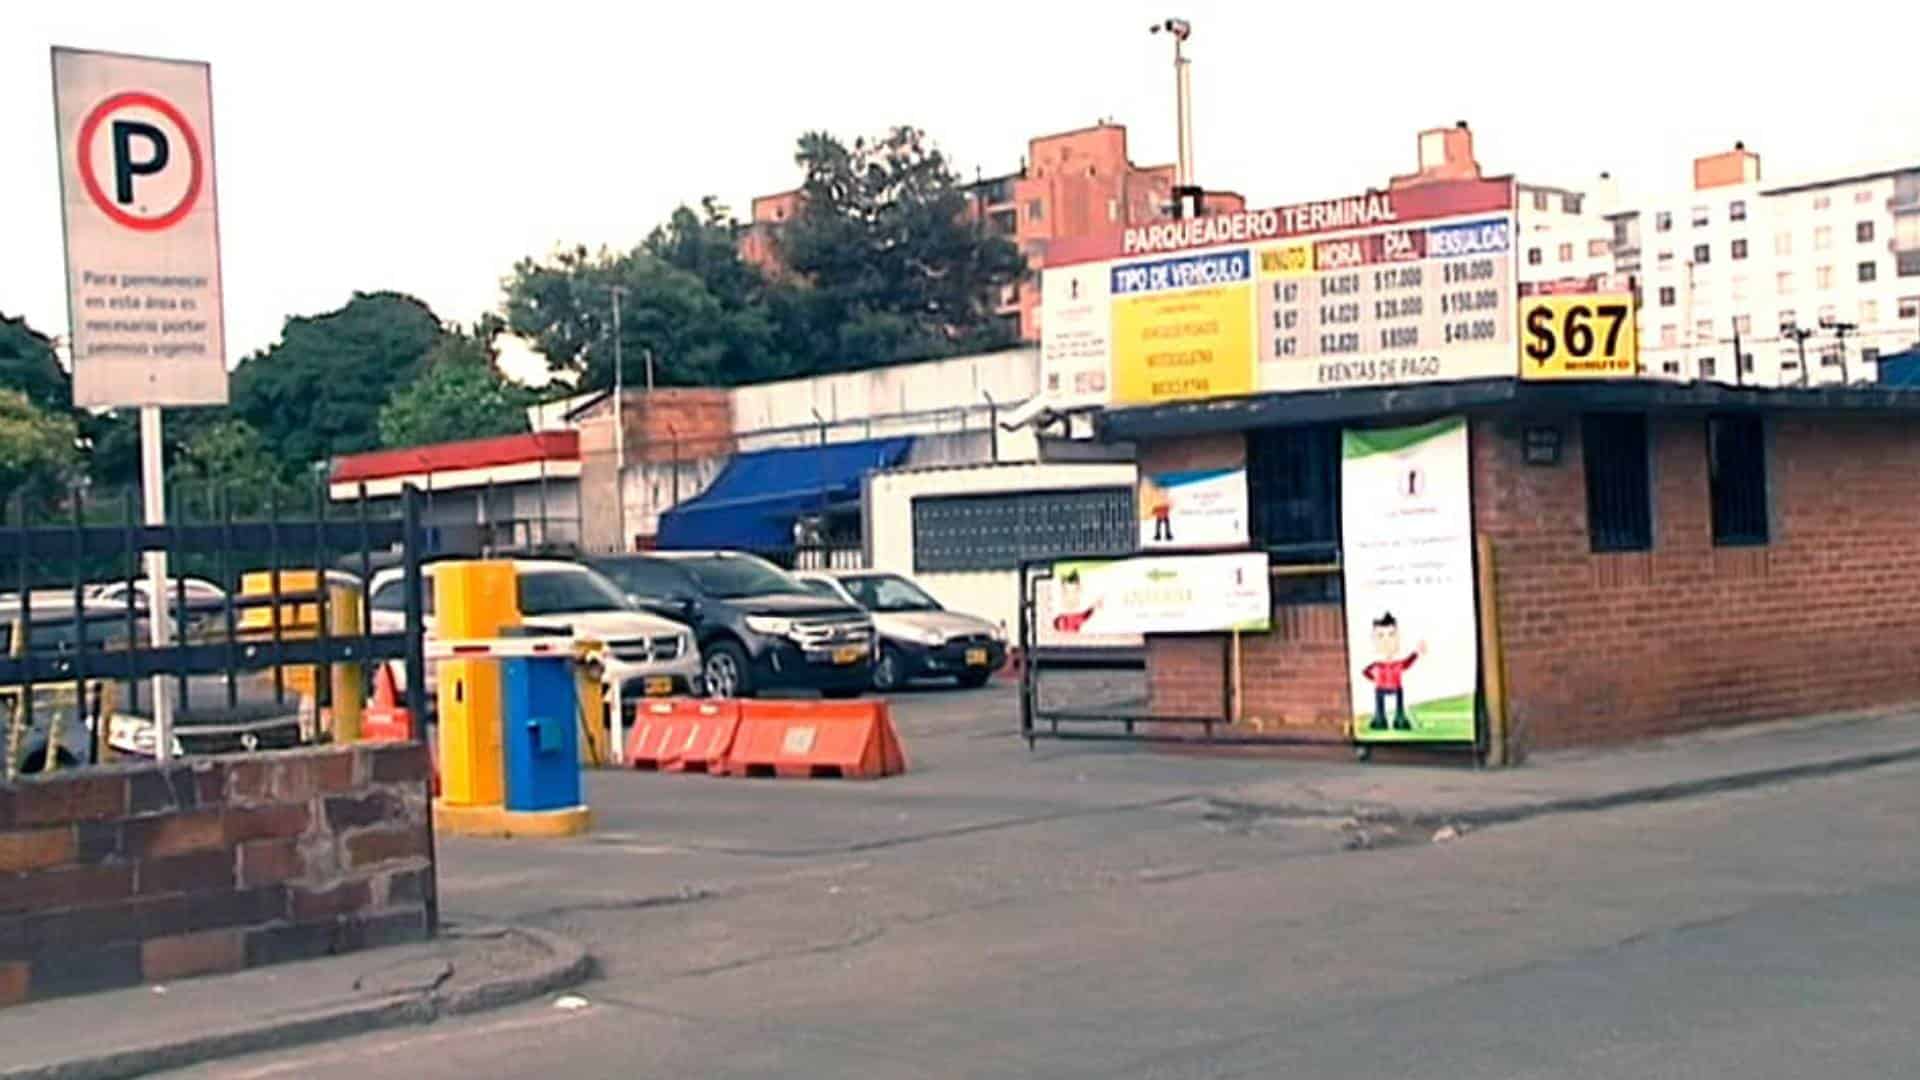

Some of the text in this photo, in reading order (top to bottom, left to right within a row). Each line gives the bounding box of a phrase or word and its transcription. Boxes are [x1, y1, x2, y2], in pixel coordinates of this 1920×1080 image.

[112, 119, 170, 205] P
[1123, 194, 1396, 254] PARQUEADERO TERMINAL
[1317, 242, 1363, 269] HORA
[83, 270, 208, 290] Para permanecer
[1116, 267, 1148, 292] TIPO
[85, 298, 105, 308] en
[109, 297, 140, 309] esta
[181, 298, 197, 310] es
[86, 320, 158, 333] necesario
[1318, 355, 1440, 383] EXENTAS DE PAGO
